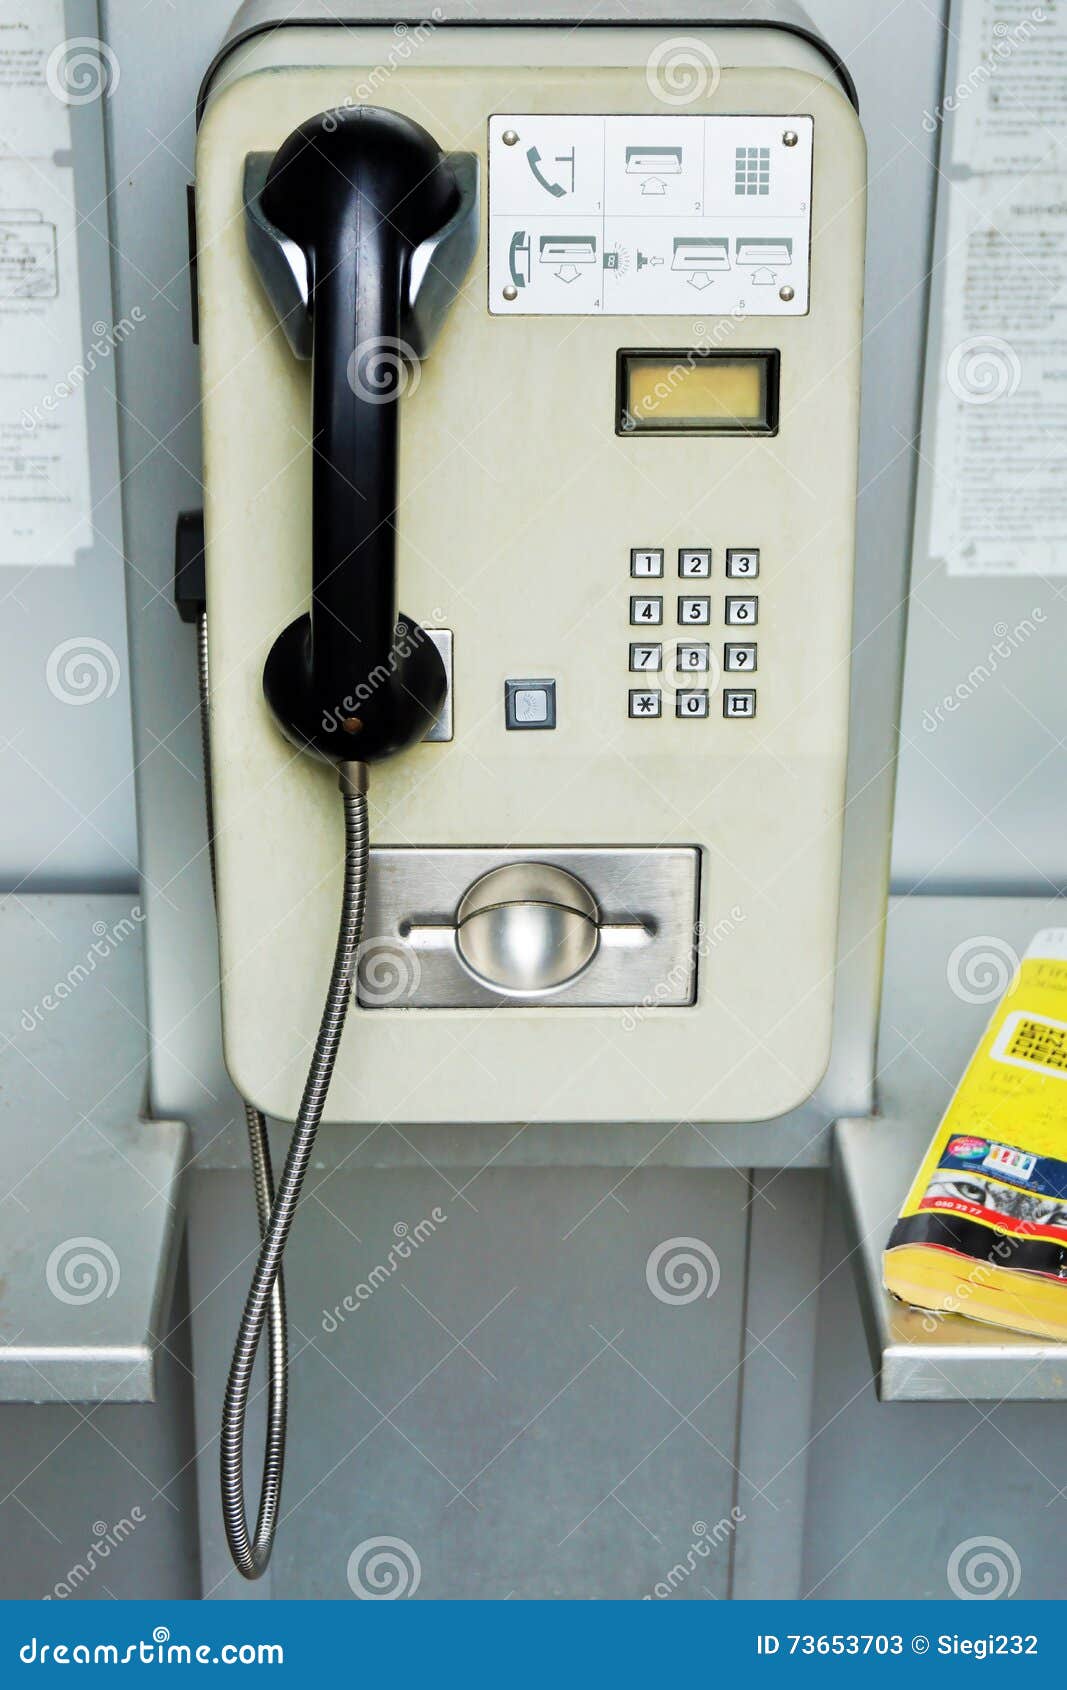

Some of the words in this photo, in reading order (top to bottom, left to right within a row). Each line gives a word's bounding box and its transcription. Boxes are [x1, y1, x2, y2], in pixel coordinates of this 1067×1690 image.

[694, 202, 701, 211] 2
[799, 202, 806, 211] 3
[593, 299, 600, 308] 4
[645, 556, 652, 572] 1
[690, 557, 702, 573] 2
[739, 557, 750, 573] 3
[641, 603, 653, 620] 4
[689, 603, 701, 619] 5
[736, 603, 748, 620] 6
[640, 651, 652, 666] 7
[689, 651, 699, 667] 8
[736, 651, 748, 667] 9
[687, 697, 699, 712] 0
[1011, 1047, 1067, 1069] HER
